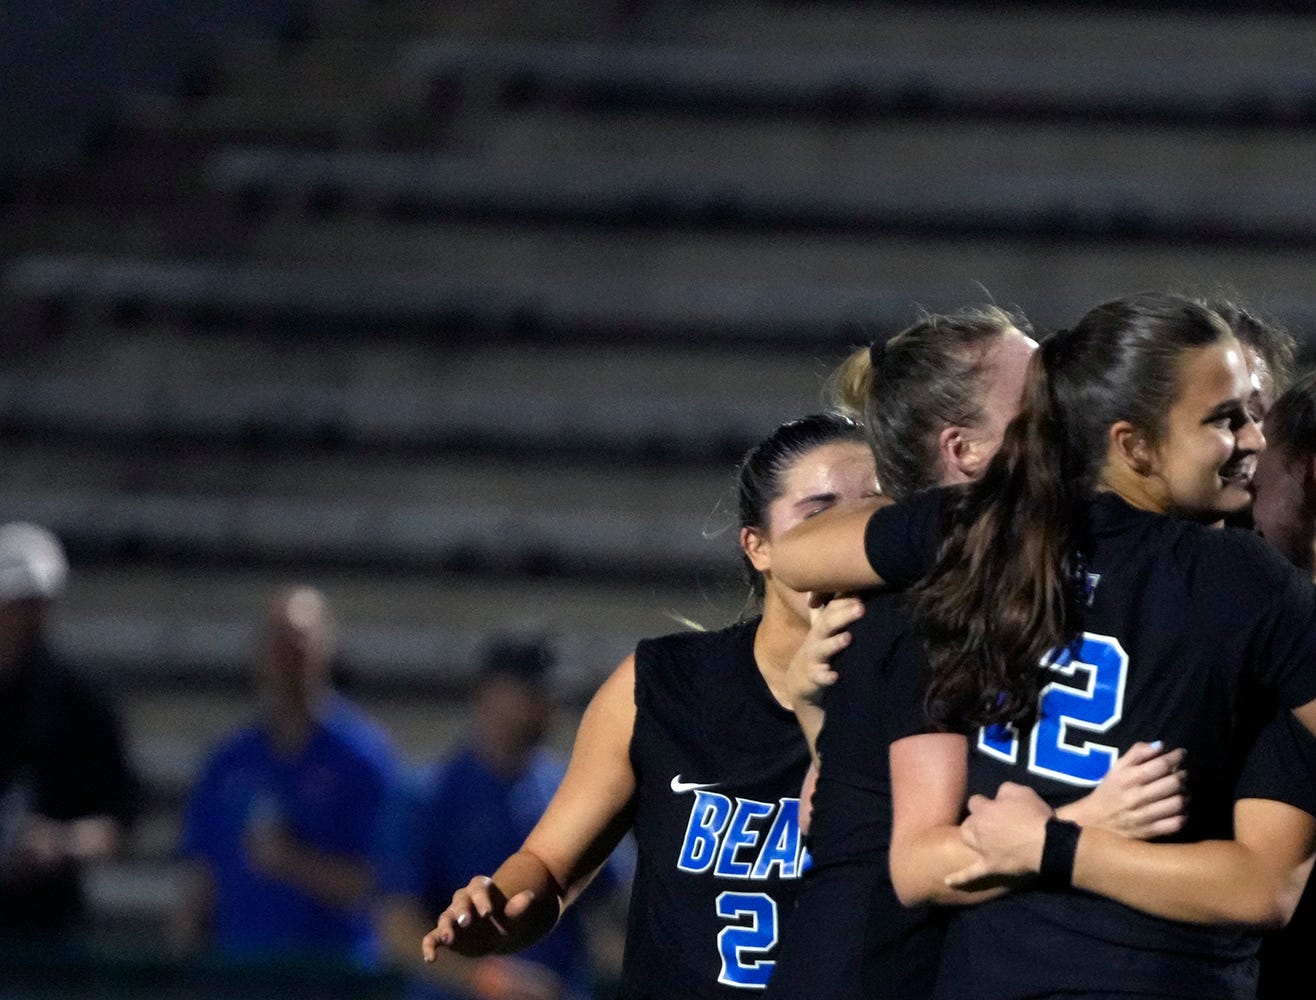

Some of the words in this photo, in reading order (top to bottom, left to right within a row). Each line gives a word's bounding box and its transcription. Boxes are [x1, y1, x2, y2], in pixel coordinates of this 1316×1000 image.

[977, 631, 1129, 788] 2
[677, 789, 814, 880] BEA
[715, 891, 778, 989] 2
